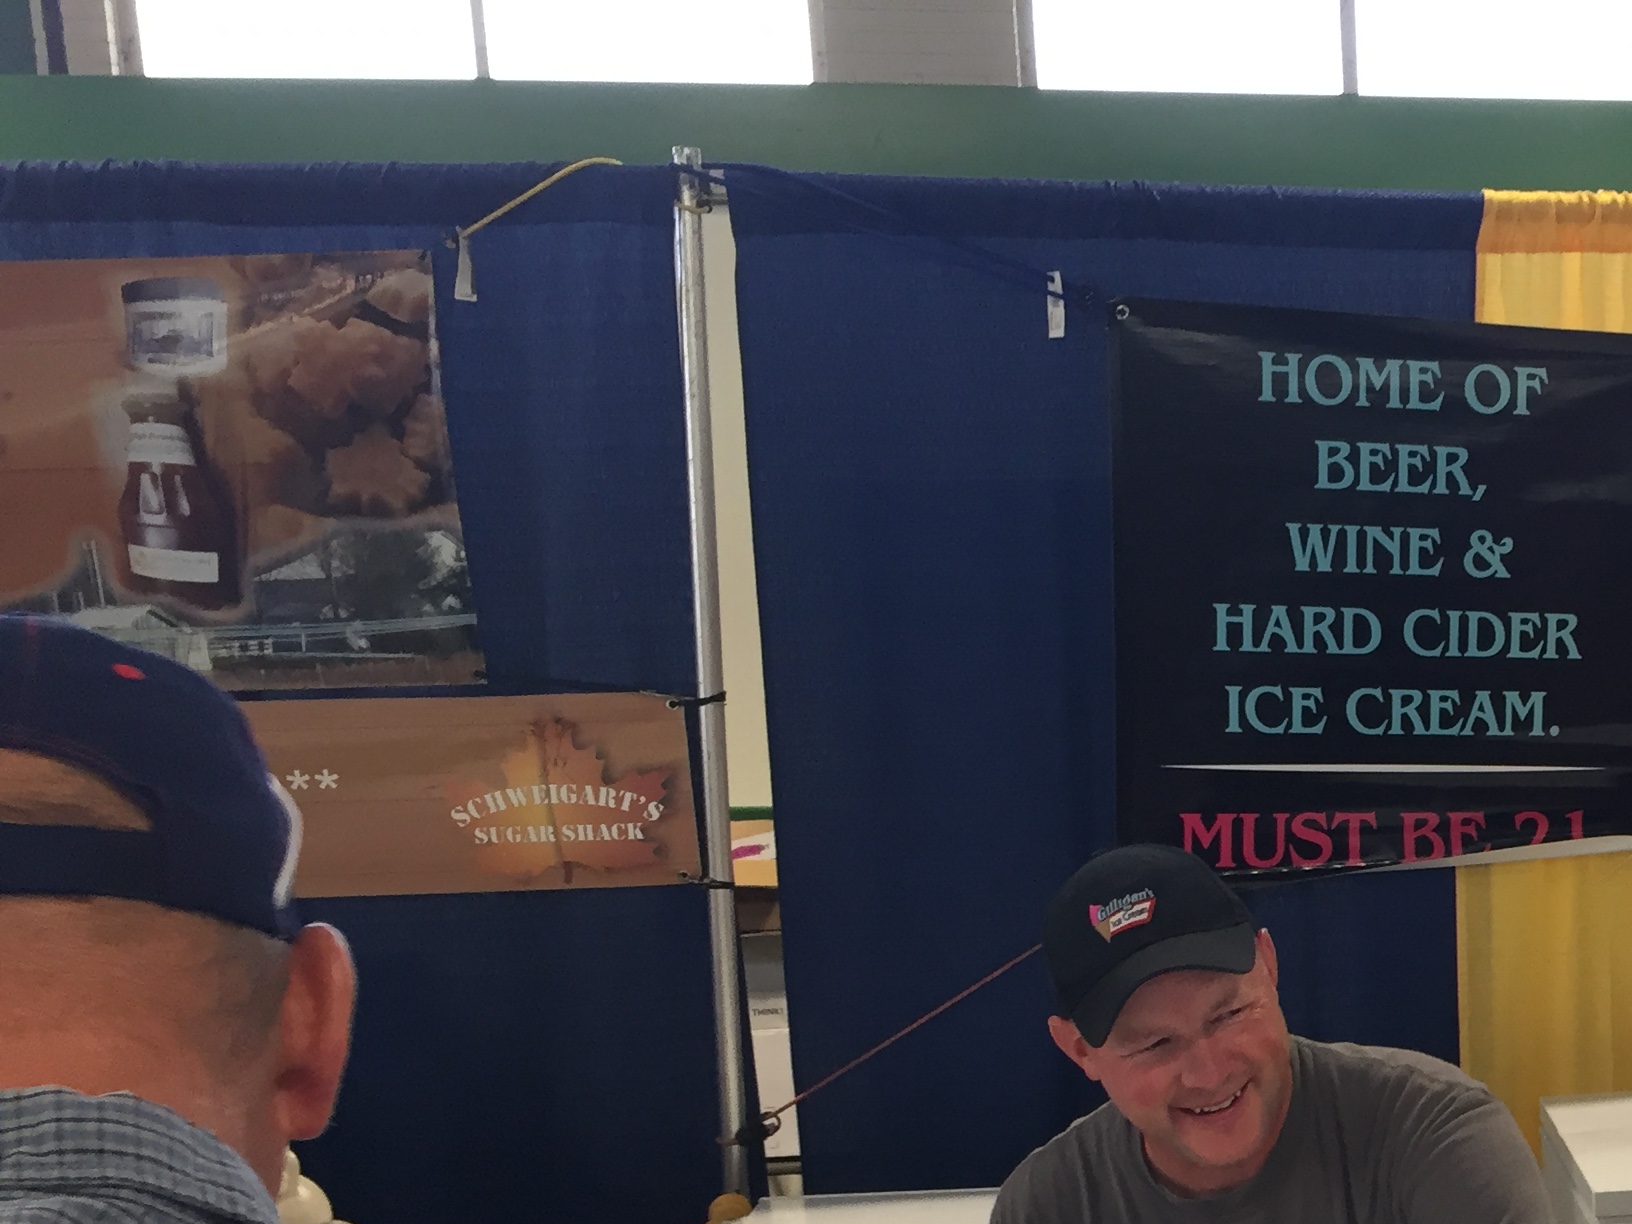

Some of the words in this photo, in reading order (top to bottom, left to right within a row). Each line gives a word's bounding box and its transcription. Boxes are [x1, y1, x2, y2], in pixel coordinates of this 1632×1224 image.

[1258, 351, 1445, 411] HOME
[1464, 364, 1549, 416] OF
[1314, 440, 1488, 501] BEER,
[1286, 522, 1444, 577] WINE
[1463, 529, 1514, 579] &
[1212, 603, 1382, 655] HARD
[1403, 608, 1582, 661] CIDER
[1225, 685, 1328, 736] ICE
[1346, 689, 1560, 737] CREAM.
[450, 783, 664, 828] SCHWEIGART'S
[474, 824, 557, 845] SUGAR
[562, 822, 645, 842] SHACK
[1179, 811, 1377, 869] MUST
[1400, 810, 1492, 865] BE
[1515, 810, 1584, 846] 21
